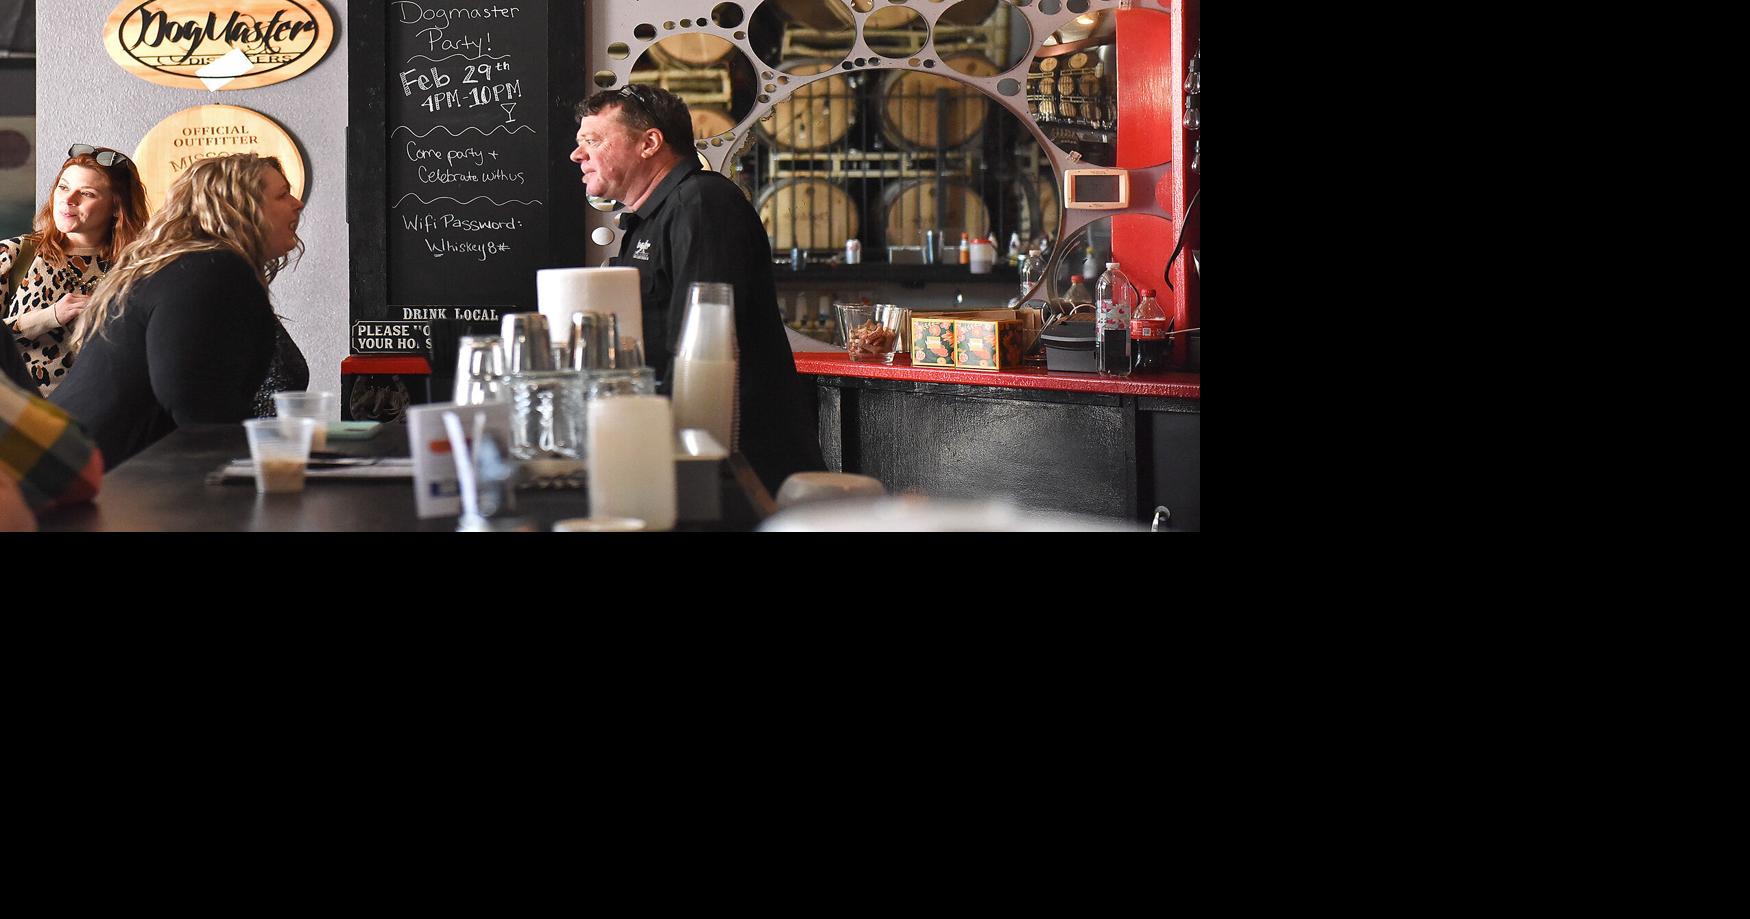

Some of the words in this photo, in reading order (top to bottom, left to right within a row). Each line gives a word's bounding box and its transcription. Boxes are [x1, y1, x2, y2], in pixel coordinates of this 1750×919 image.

[391, 1, 520, 29] Dogmaster
[131, 7, 317, 62] DogMaster
[415, 27, 492, 57] Party!
[400, 67, 450, 97] Feb
[182, 125, 249, 137] OFFICIAL
[173, 136, 258, 148] OUTFITTER
[406, 140, 442, 162] Come
[447, 147, 484, 167] party
[418, 165, 479, 184] Celebrate
[402, 213, 438, 233] Wifi
[440, 213, 524, 231] Password:
[402, 307, 448, 321] DRINK
[454, 307, 499, 322] LOCAL
[358, 324, 410, 337] PLEASE
[357, 337, 393, 349] YOUR
